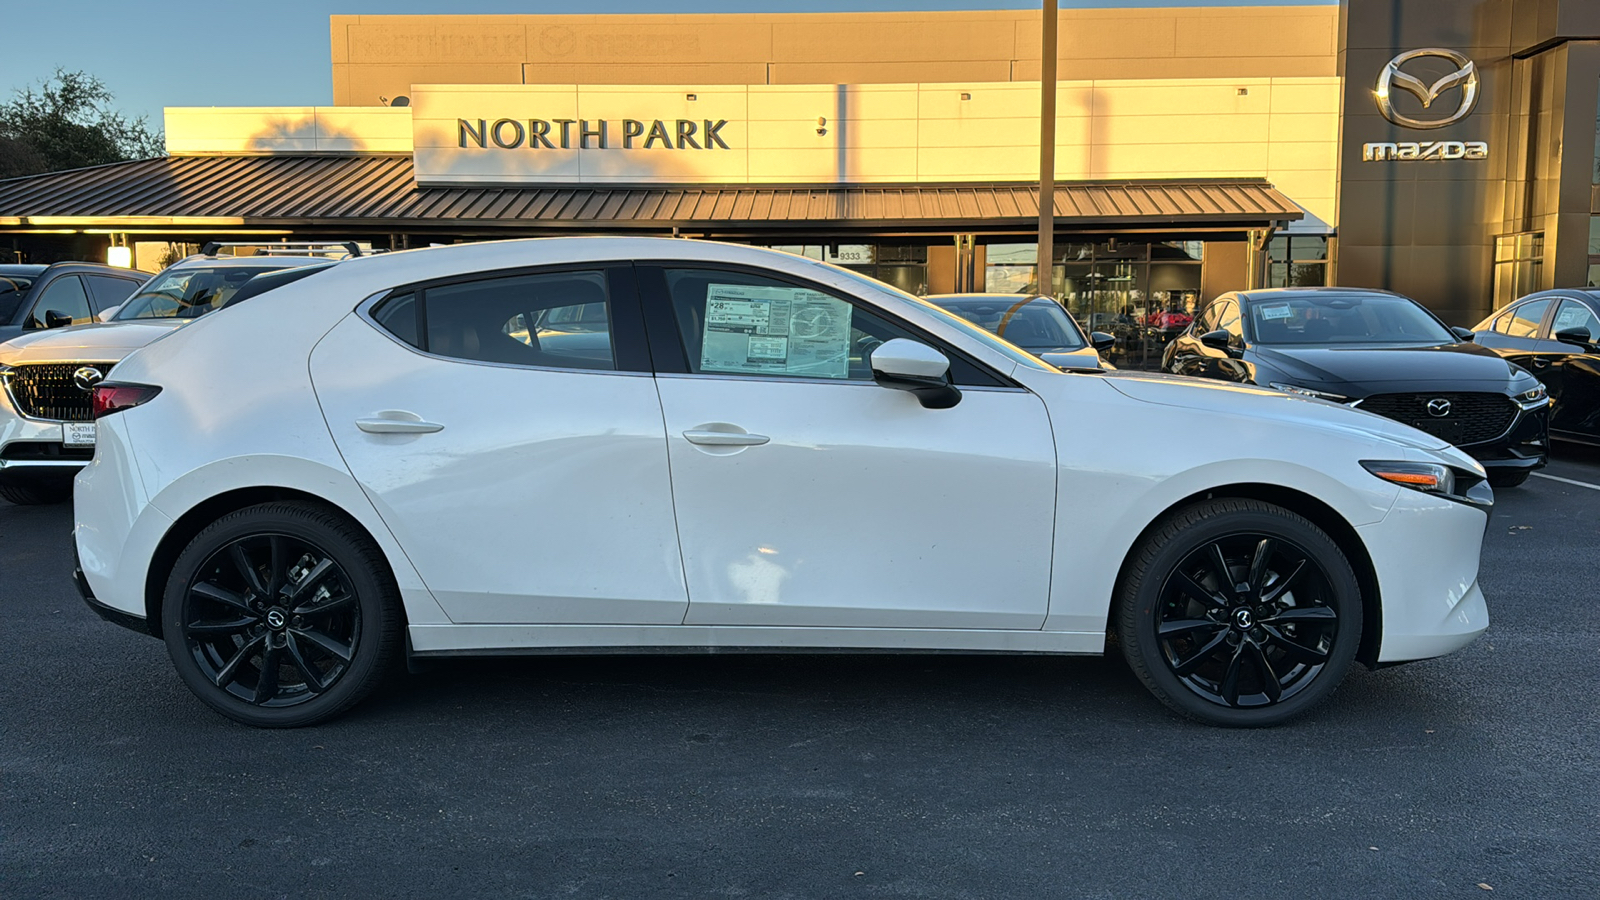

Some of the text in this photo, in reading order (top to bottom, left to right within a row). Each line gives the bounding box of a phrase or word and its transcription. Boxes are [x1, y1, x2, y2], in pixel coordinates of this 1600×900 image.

[458, 118, 731, 150] NORTH PARK
[840, 252, 860, 260] 9333
